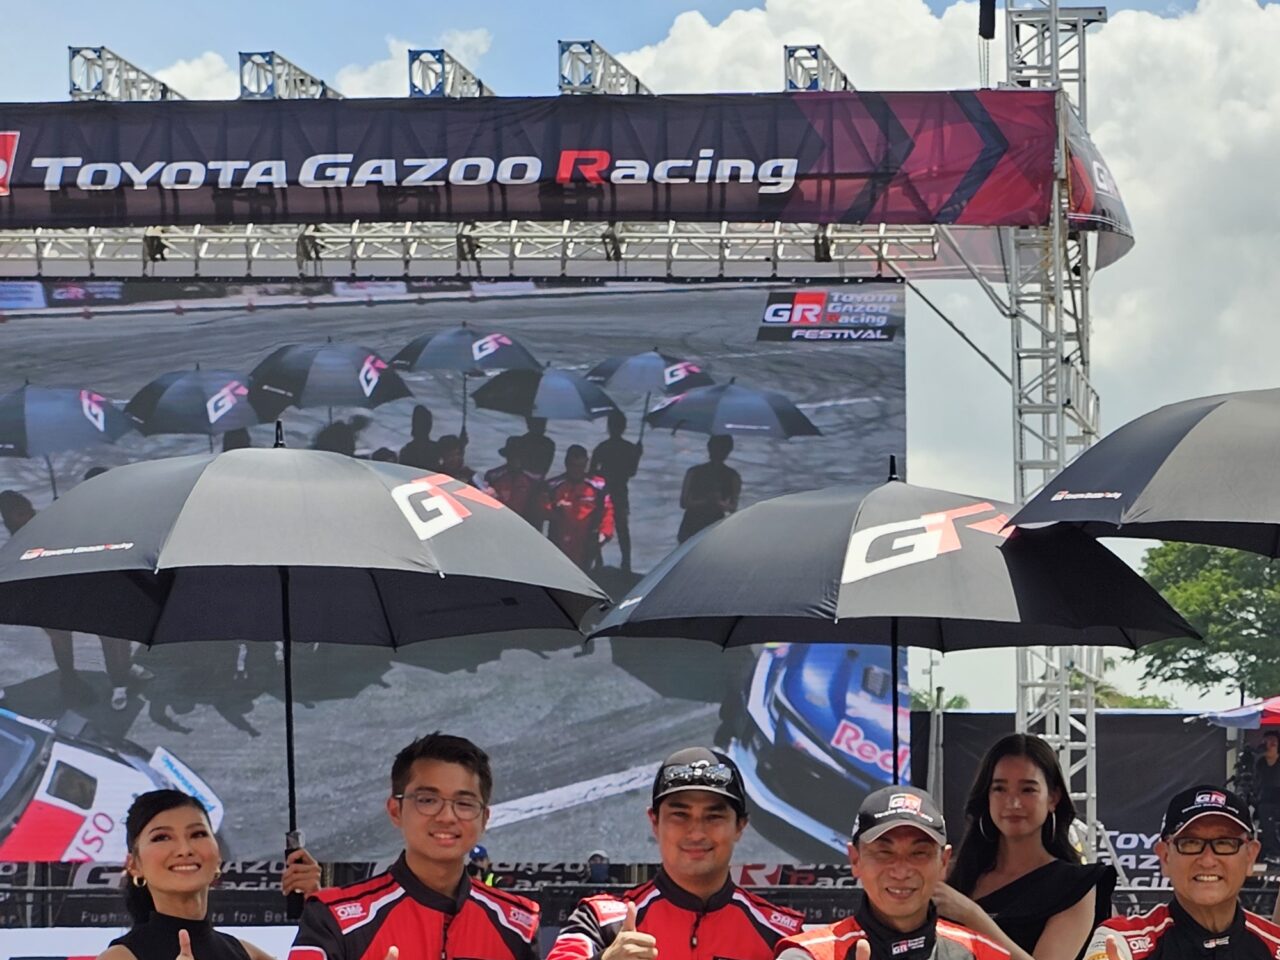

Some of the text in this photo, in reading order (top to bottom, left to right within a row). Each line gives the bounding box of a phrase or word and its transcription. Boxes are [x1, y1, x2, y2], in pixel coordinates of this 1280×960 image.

[31, 155, 288, 191] TOYOTA
[298, 154, 542, 188] GAZOO
[556, 148, 800, 195] Racing
[764, 303, 822, 323] GR
[792, 329, 889, 339] FESTIVAL
